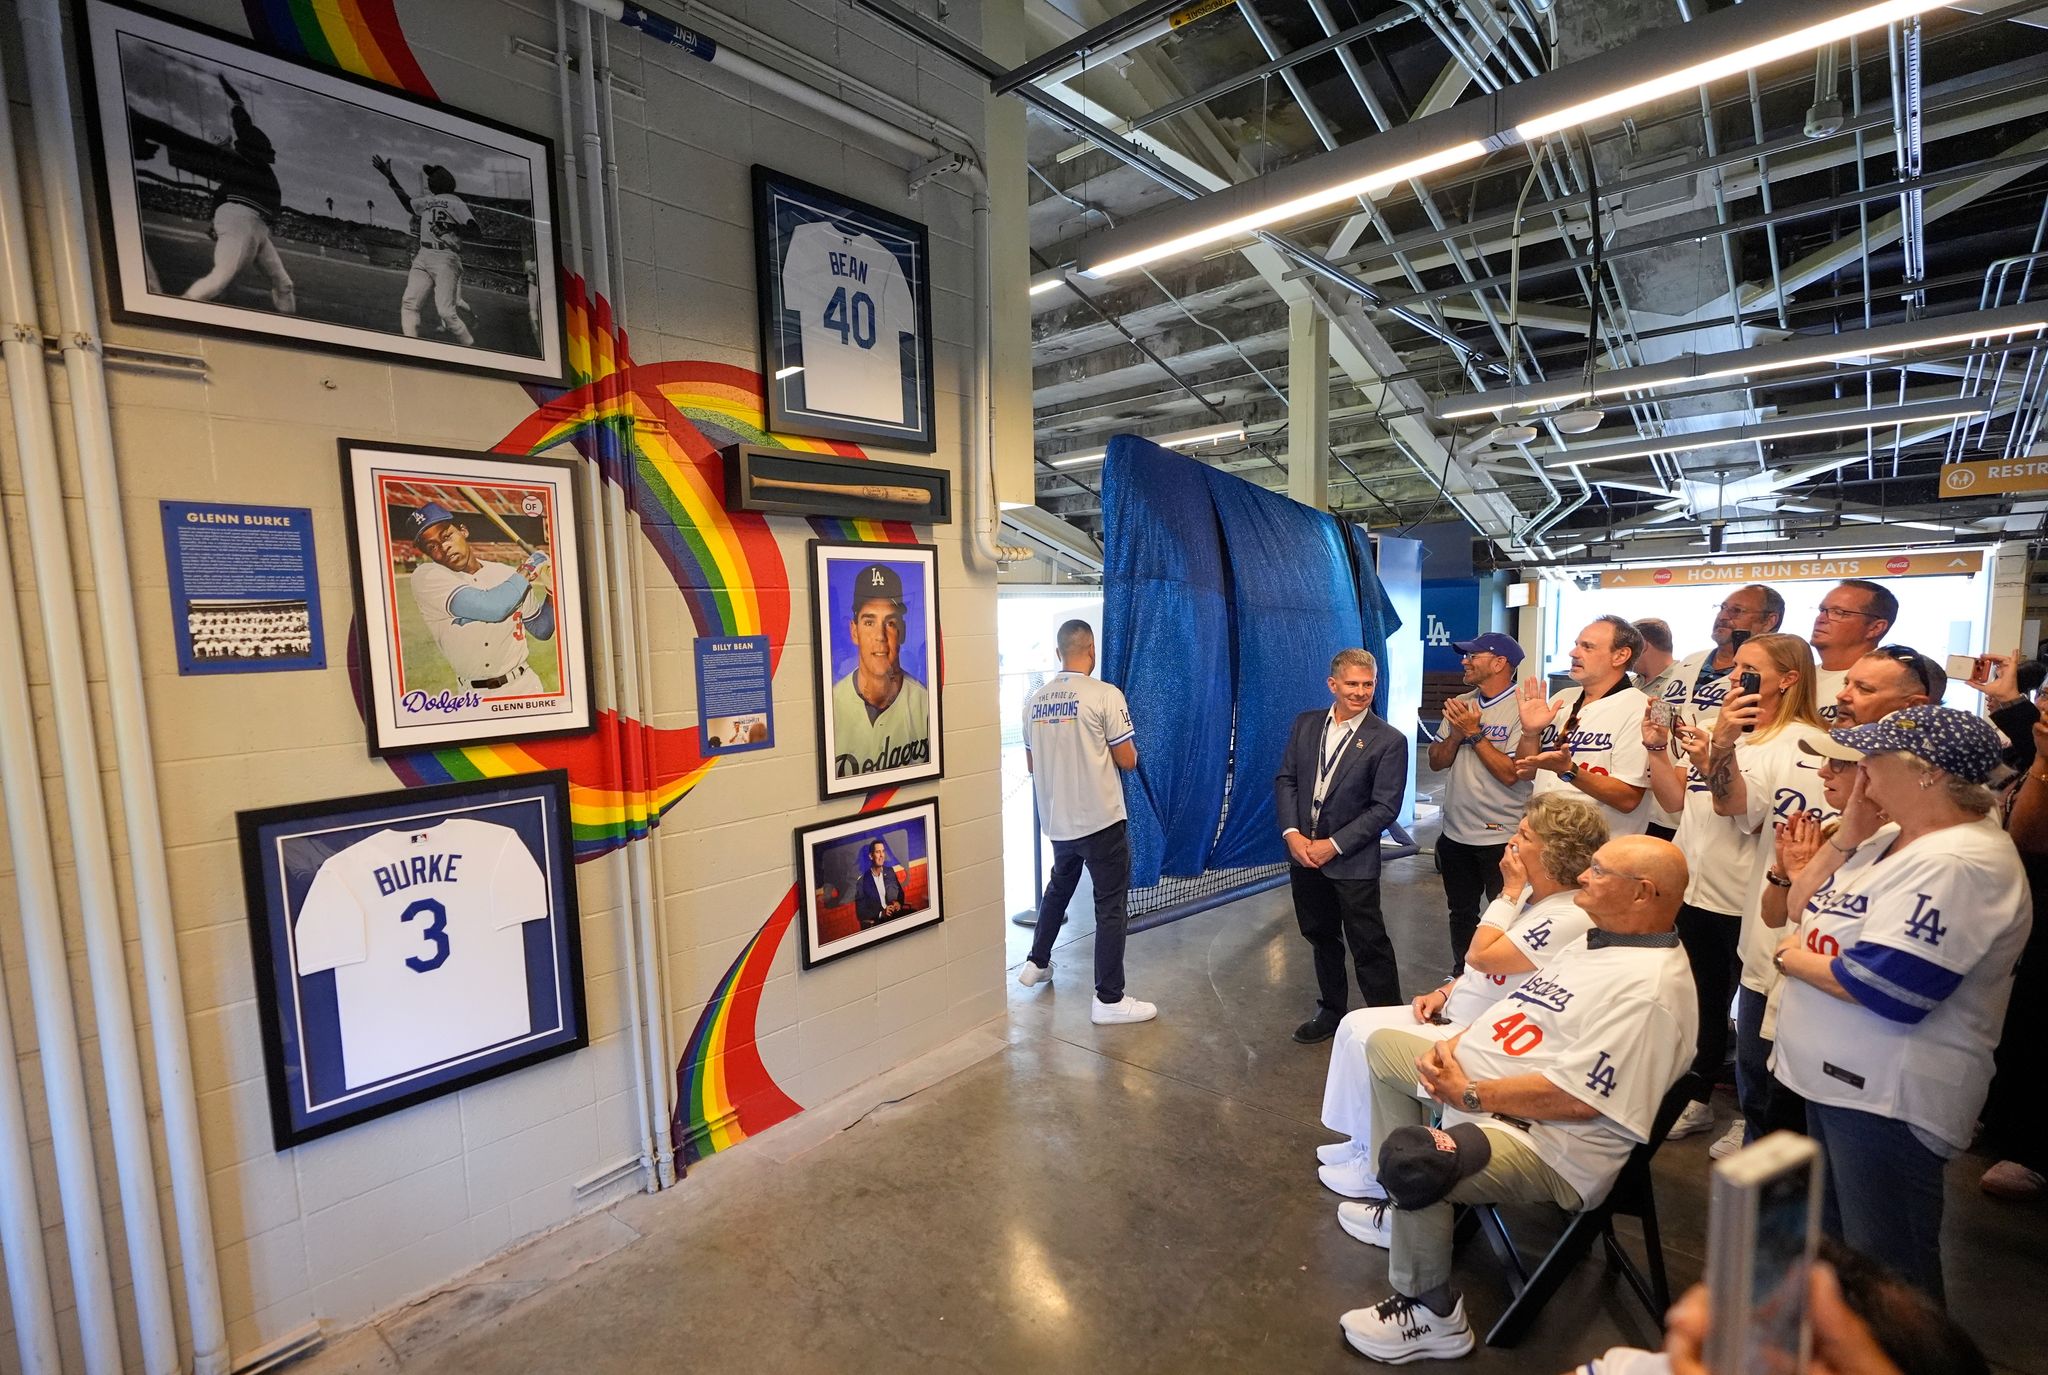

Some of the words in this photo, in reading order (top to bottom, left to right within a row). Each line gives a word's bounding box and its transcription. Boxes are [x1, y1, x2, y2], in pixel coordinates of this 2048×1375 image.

[673, 26, 698, 47] VENT
[828, 251, 868, 284] BEAN
[823, 286, 876, 349] 40
[524, 503, 538, 511] OF
[186, 512, 240, 525] GLENN
[244, 515, 291, 527] BURKE
[871, 567, 885, 586] LA
[1687, 566, 1744, 581] HOME
[1751, 564, 1791, 577] RUN
[1799, 560, 1860, 575] SEATS
[1426, 614, 1450, 646] LA
[712, 643, 732, 651] BILLY
[733, 642, 753, 650] BEAN
[402, 691, 481, 713] Dodgers
[491, 703, 524, 712] GLENN
[526, 699, 556, 710] BURKE
[1039, 693, 1049, 702] THE
[1050, 691, 1067, 700] PRIDE
[1032, 700, 1079, 719] CHAMPIONS
[373, 854, 463, 897] BURKE
[1904, 893, 1947, 946] LA
[400, 897, 450, 973] 3
[1523, 917, 1553, 950] LA
[1491, 1012, 1544, 1056] 40
[1585, 1051, 1617, 1098] LA
